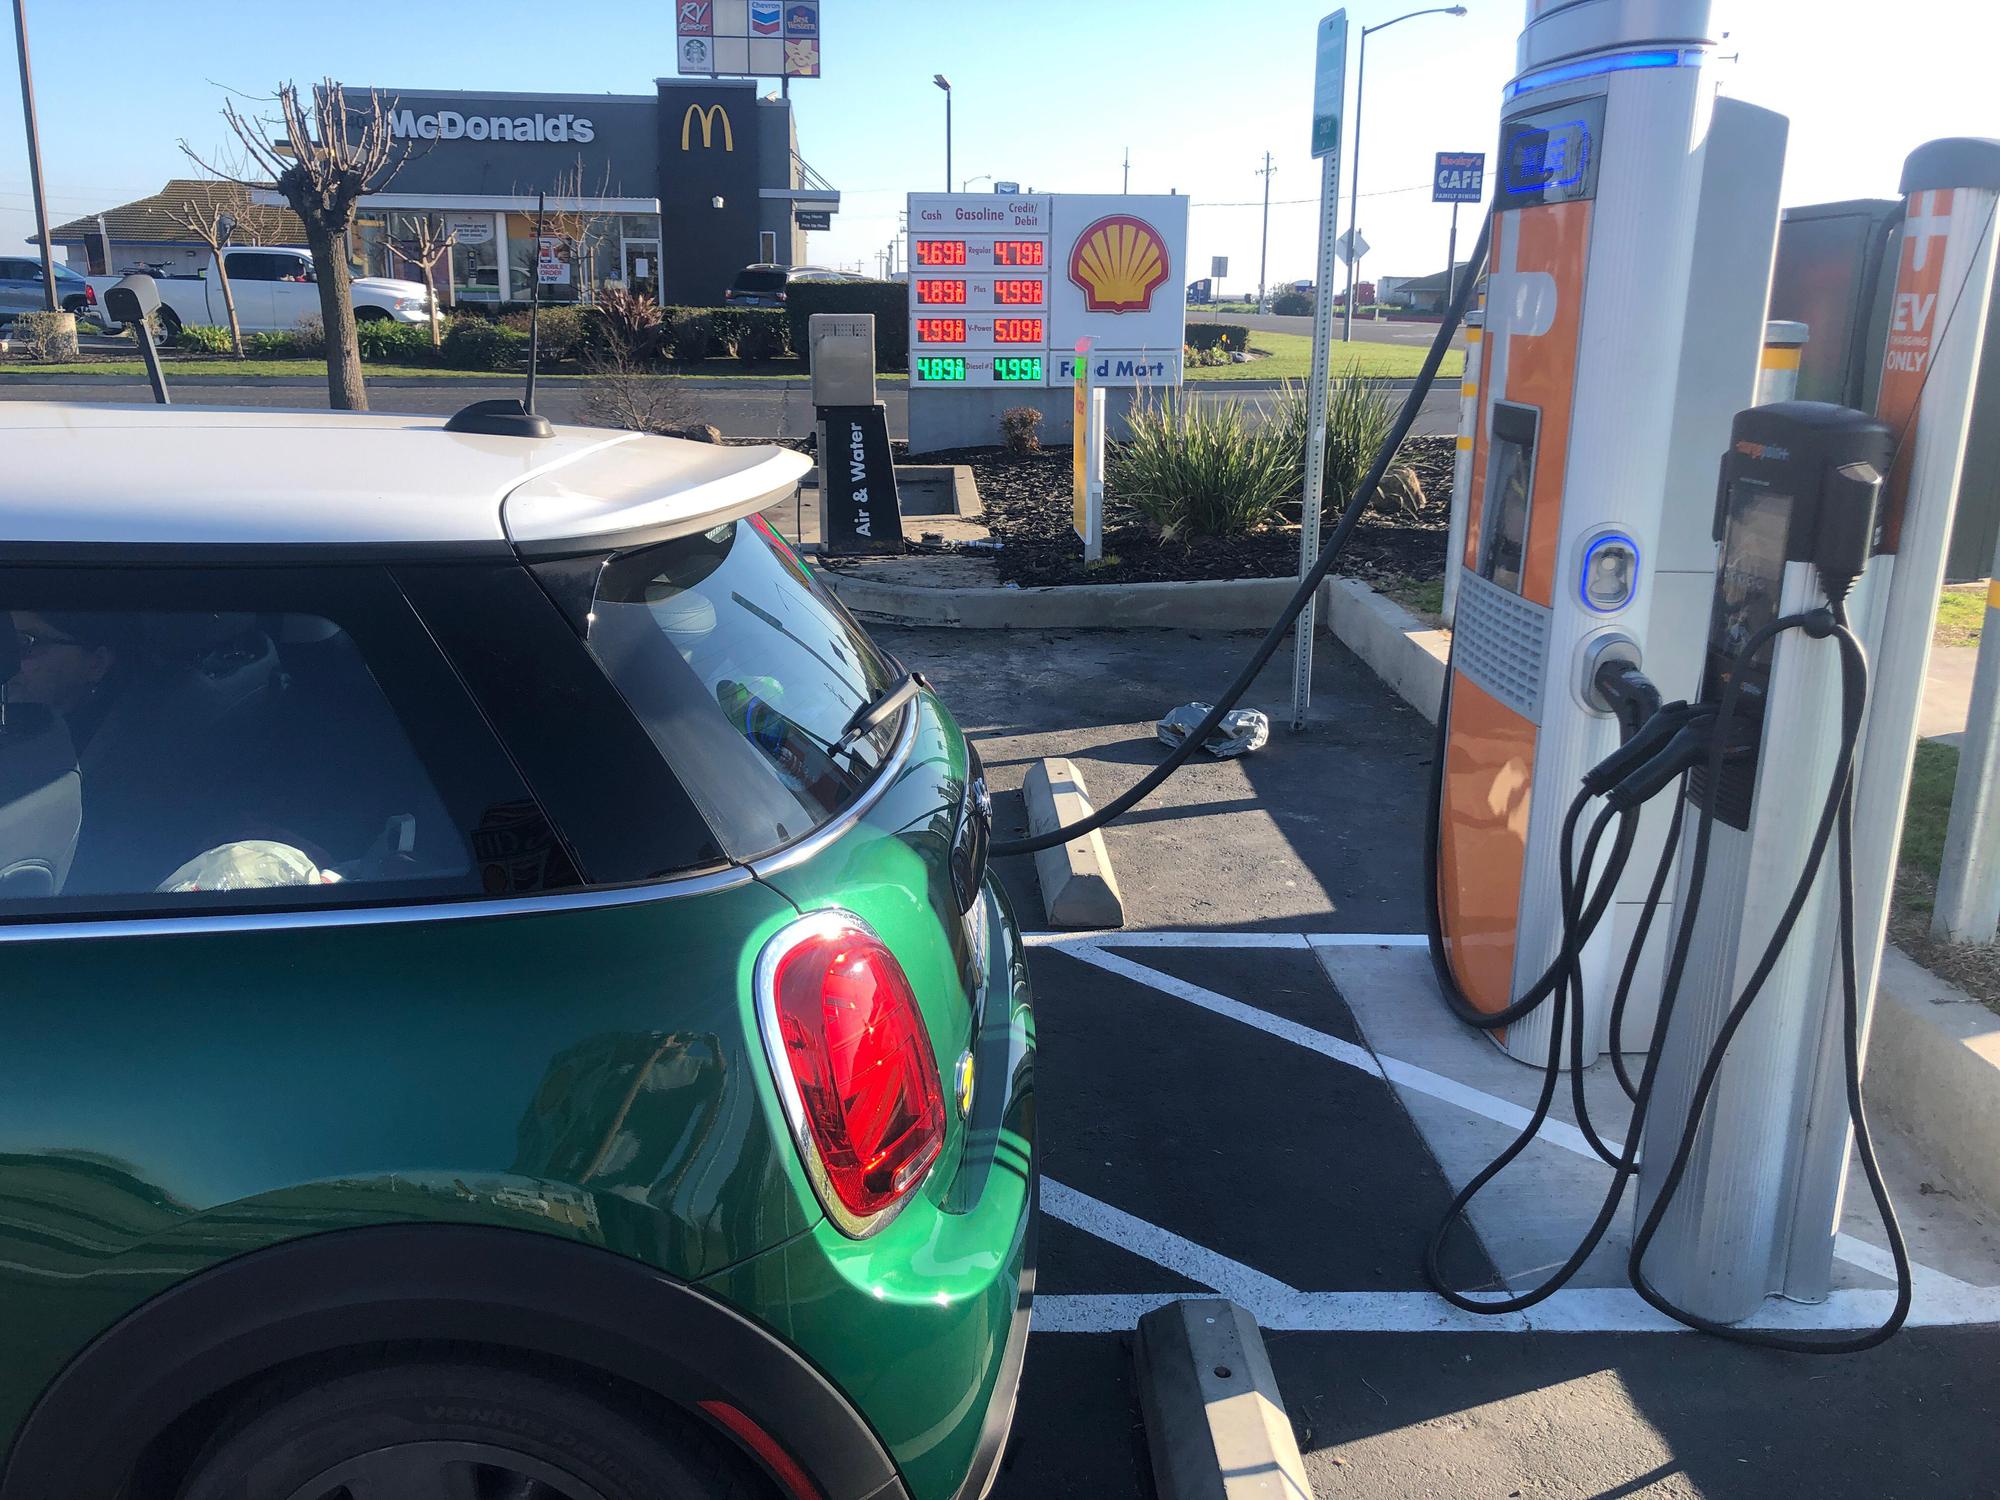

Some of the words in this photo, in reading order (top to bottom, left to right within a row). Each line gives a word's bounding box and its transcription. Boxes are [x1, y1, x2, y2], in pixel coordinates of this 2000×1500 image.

[680, 2, 707, 23] RV
[752, 1, 780, 9] Chevron
[793, 15, 808, 24] Best
[384, 109, 595, 144] McDonald's
[1438, 170, 1482, 189] CAFE
[921, 209, 942, 221] Cash
[955, 207, 1005, 221] Gasoline
[1008, 202, 1038, 214] Credit/
[1014, 215, 1038, 226] Debit
[968, 246, 991, 256] Regular
[974, 285, 987, 293] Plus
[1893, 293, 1936, 331] EV
[967, 324, 992, 332] V-Power
[966, 362, 985, 370] Diesel
[1060, 360, 1109, 377] Fd
[1115, 361, 1164, 377] Mart
[1886, 351, 1927, 372] ONLY
[850, 422, 867, 482] Water
[852, 487, 869, 503] &
[854, 509, 872, 537] Air
